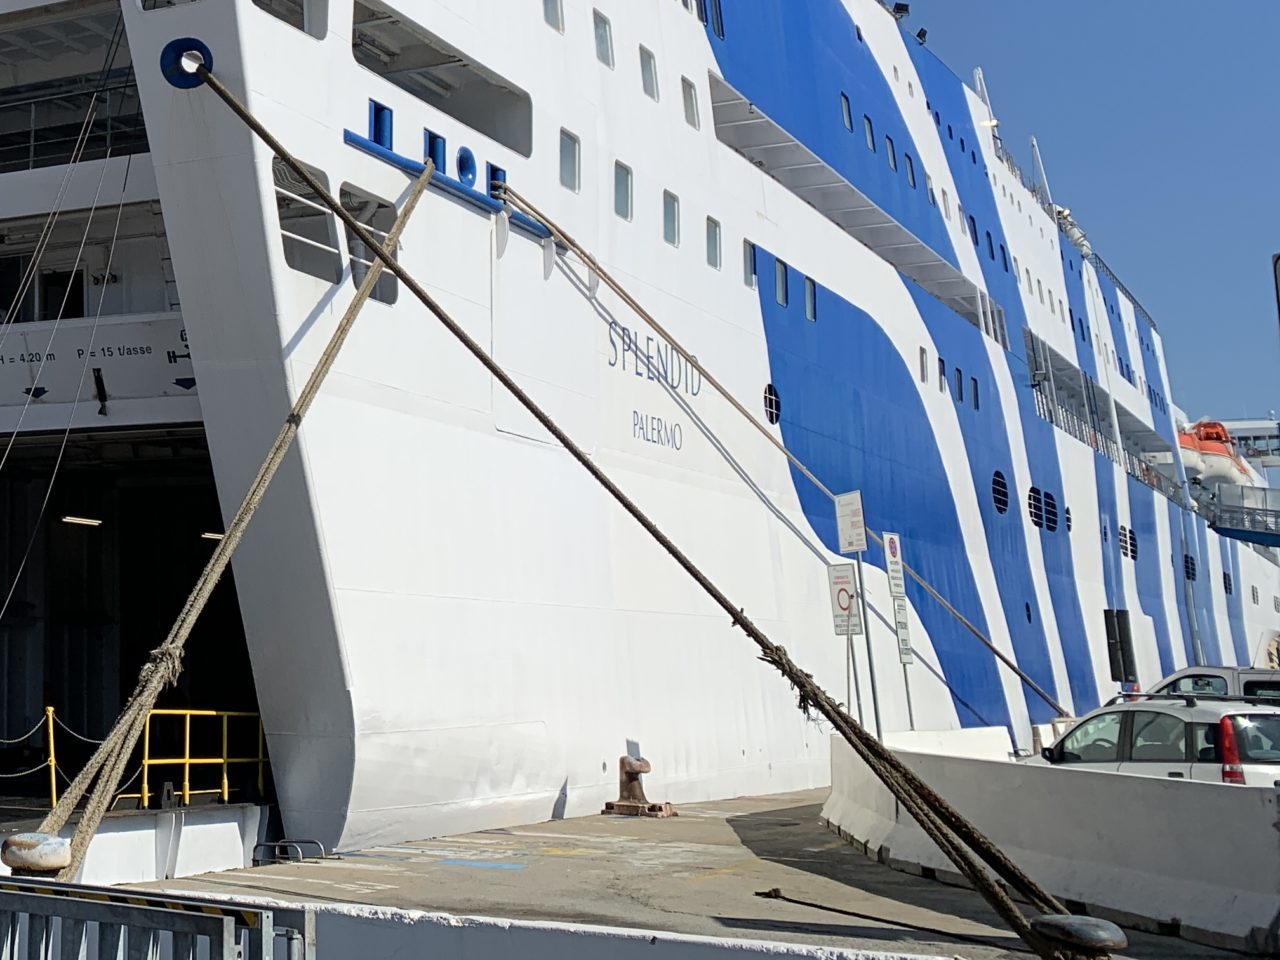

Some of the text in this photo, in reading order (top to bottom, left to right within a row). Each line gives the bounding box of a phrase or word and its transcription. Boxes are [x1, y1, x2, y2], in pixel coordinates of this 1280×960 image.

[19, 351, 42, 364] 4.20
[46, 351, 56, 362] m
[76, 348, 85, 360] P
[100, 346, 114, 358] 15
[117, 344, 153, 357] t/asse
[608, 320, 702, 397] SPLENDID
[632, 410, 683, 451] PALERMO
